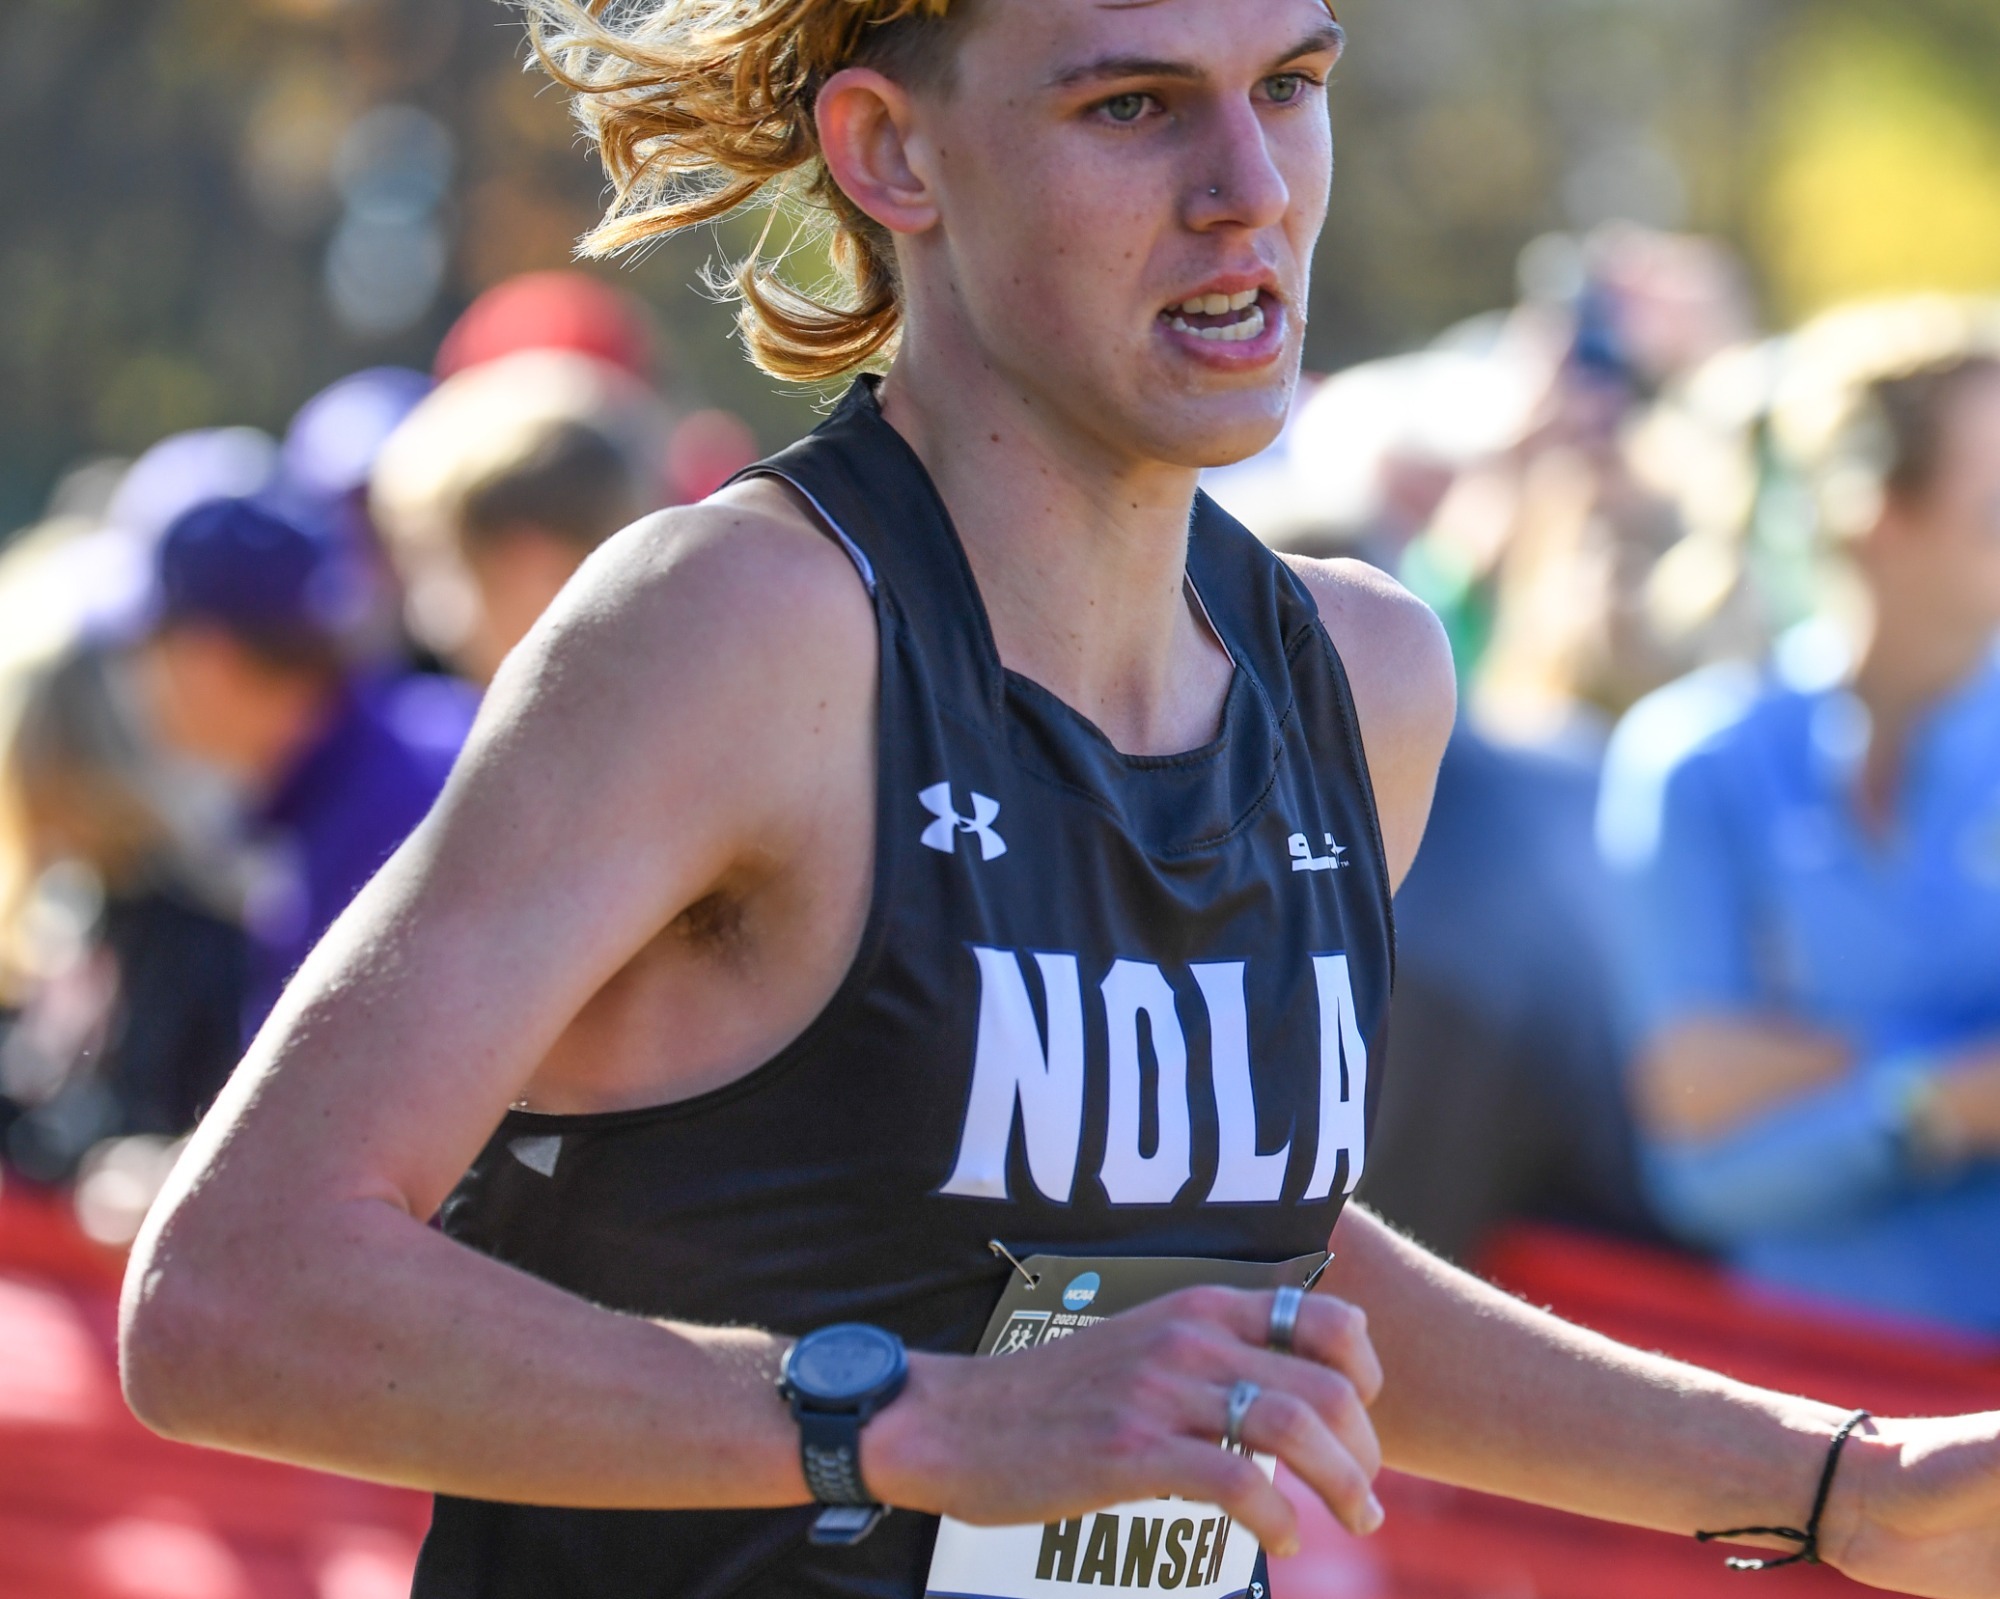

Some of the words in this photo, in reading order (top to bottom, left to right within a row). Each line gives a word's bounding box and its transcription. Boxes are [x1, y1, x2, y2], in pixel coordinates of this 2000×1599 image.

[938, 946, 1368, 1204] NOLA
[1065, 1289, 1095, 1300] NCAA
[1052, 1313, 1078, 1326] 2023
[1035, 1512, 1232, 1591] HANSEN
